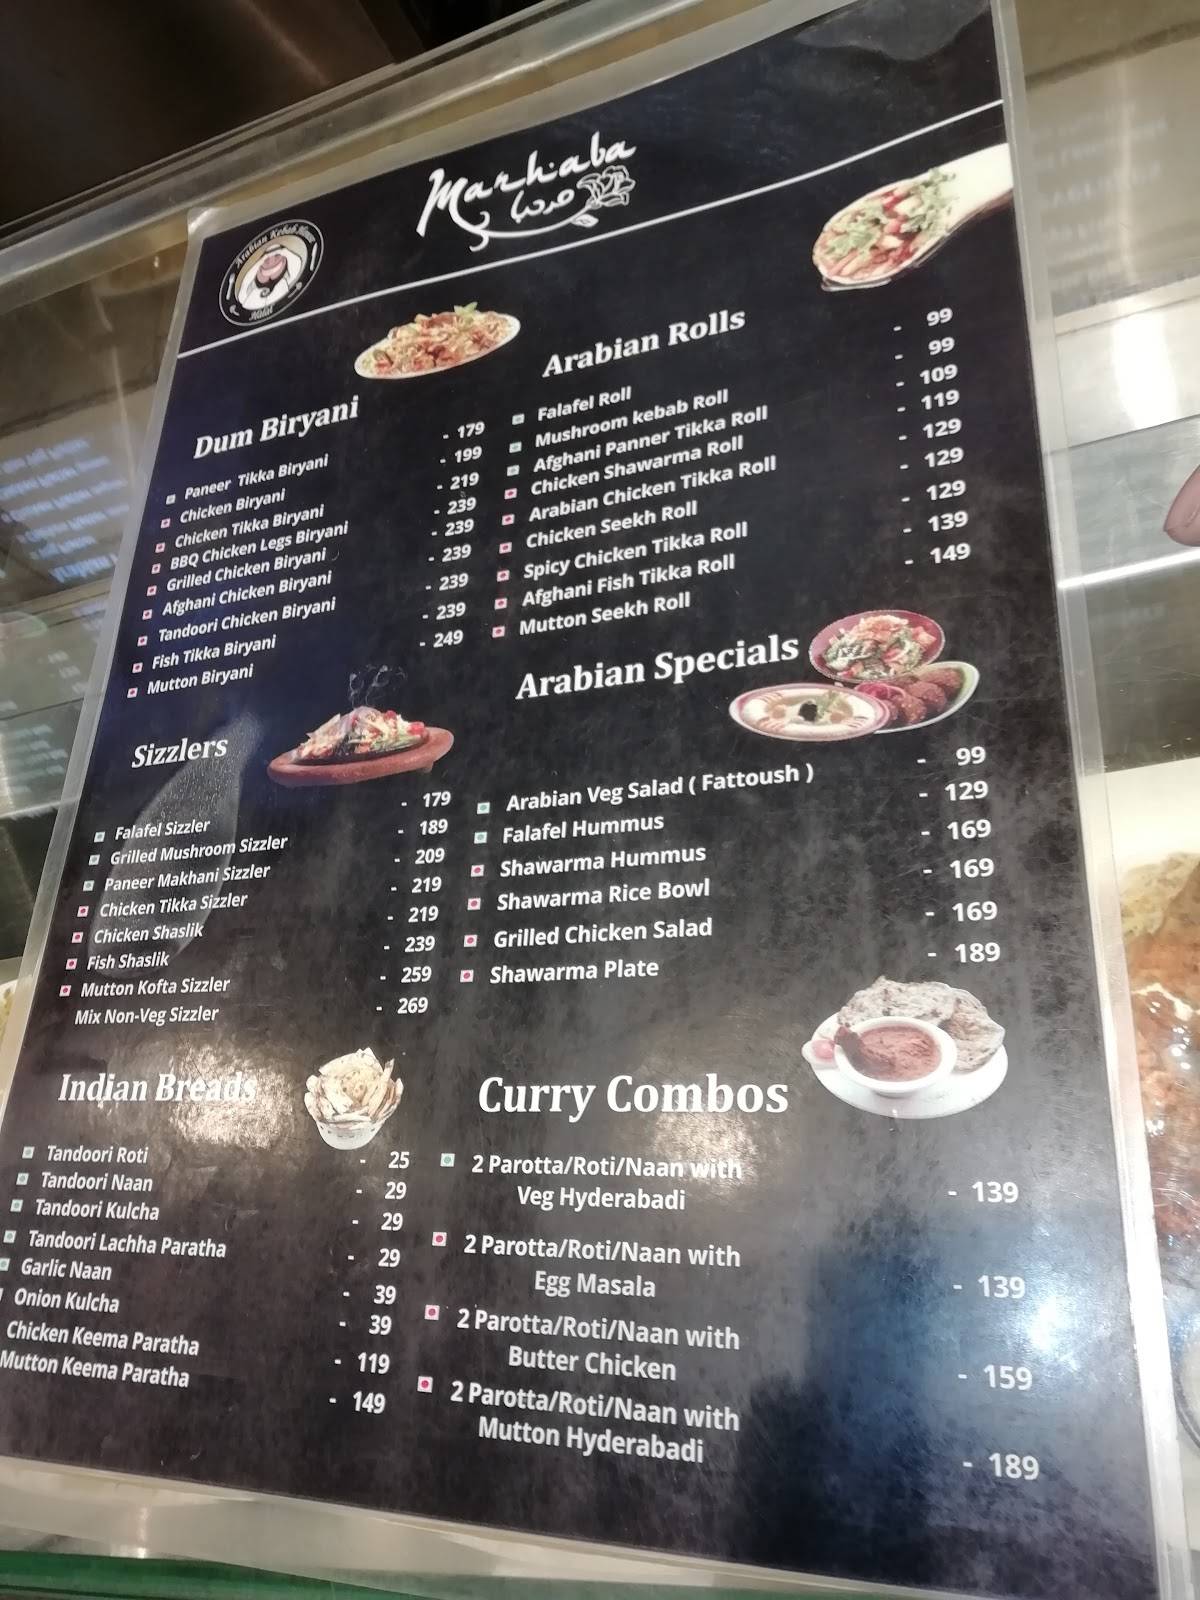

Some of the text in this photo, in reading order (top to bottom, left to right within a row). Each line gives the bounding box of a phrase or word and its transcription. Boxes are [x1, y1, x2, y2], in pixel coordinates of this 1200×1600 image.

[927, 308, 953, 326] 99
[542, 310, 745, 378] Arabian Rolls
[928, 337, 955, 355] 99
[920, 364, 958, 384] 109
[538, 386, 631, 421] Falafel Roll
[921, 390, 959, 410] 119
[193, 395, 359, 459] Dum Biryani
[458, 421, 485, 438] 179
[535, 389, 728, 447] Mushroom kebab Roll
[533, 405, 767, 472] Afghani Panner Tikka Roll
[455, 446, 482, 463] 199
[531, 435, 743, 495] Chicken Shawarma Roll
[185, 453, 328, 500] Paneer Tikka Biryani
[450, 472, 479, 490] 219
[926, 480, 966, 500] 129
[180, 488, 285, 523] Chicken Biryani
[447, 497, 476, 515] 239
[175, 504, 324, 548] Chicken Tikka Biryani
[526, 500, 697, 548] Chicken Seekh Roll
[928, 511, 968, 531] 139
[170, 520, 348, 570] BBQ Chicken Legs Biryani
[930, 543, 971, 563] 149
[522, 553, 735, 607] Afghani Fish Tikka Roll
[159, 596, 336, 642] Tandoori Chicken Biryani
[436, 602, 466, 620] 239
[520, 591, 690, 635] Mutton Seekh Roll
[152, 634, 276, 669] Fish Tikka Biryani
[433, 630, 463, 648] 249
[147, 663, 254, 694] Mutton Biryani
[515, 634, 799, 700] Arabian Specials
[131, 738, 228, 768] Sizzlers
[956, 746, 986, 766] 99
[423, 791, 451, 807] 179
[506, 764, 799, 811] Arabian Veg Salad Fattoush
[945, 780, 988, 801] 129
[115, 819, 210, 840] Falafel Sizzler
[420, 819, 448, 835] 189
[503, 816, 664, 843] Falafel Hummus
[111, 835, 288, 865] Grilled Mushroom Sizzler
[415, 847, 445, 864] 209
[500, 847, 706, 877] Shawarma Hummus
[100, 892, 248, 917] Chicken Tikka Sizzler
[408, 905, 439, 923] 219
[952, 901, 997, 922] 169
[94, 922, 204, 943] Chicken Shaslik
[494, 917, 712, 948] Grilled Chicken Salad
[87, 951, 170, 970] Fish Shaslik
[955, 942, 1000, 963] 189
[401, 966, 432, 983] 259
[490, 959, 659, 984] Shawarma Plate
[75, 1005, 219, 1026] Mix Non-Veg Sizzler
[397, 997, 428, 1014] 269
[57, 1072, 258, 1103] Indian Breads
[479, 1073, 788, 1123] Curry Combos
[48, 1145, 149, 1163] Tandoori Roti
[388, 1151, 410, 1169] 25
[472, 1155, 743, 1180] 2 Parotta/Roti/Naan with
[517, 1186, 685, 1212] Veg Hyderabadi
[972, 1181, 1018, 1203] 139
[36, 1199, 159, 1220] Tandoori Kulcha
[29, 1230, 226, 1258] Tandoori Lachha Paratha
[464, 1234, 740, 1267] 2 Parotta/Roti/Naan with
[21, 1258, 112, 1280] Garlic Naan
[378, 1248, 400, 1267] 29
[374, 1285, 396, 1305] 39
[535, 1270, 655, 1297] Egg Masala
[978, 1275, 1025, 1299] 139
[15, 1288, 119, 1313] Onion Kulcha
[0, 1350, 189, 1387] Mutton Keema Paratha
[358, 1352, 390, 1374] 119
[509, 1345, 676, 1380] Butter Chicken
[983, 1364, 1032, 1390] 159
[353, 1391, 386, 1414] 149
[450, 1380, 739, 1431] 2 Parotta/Roti/Naan with
[479, 1416, 703, 1463] Mutton Hyderabadi
[989, 1453, 1039, 1480] 189
